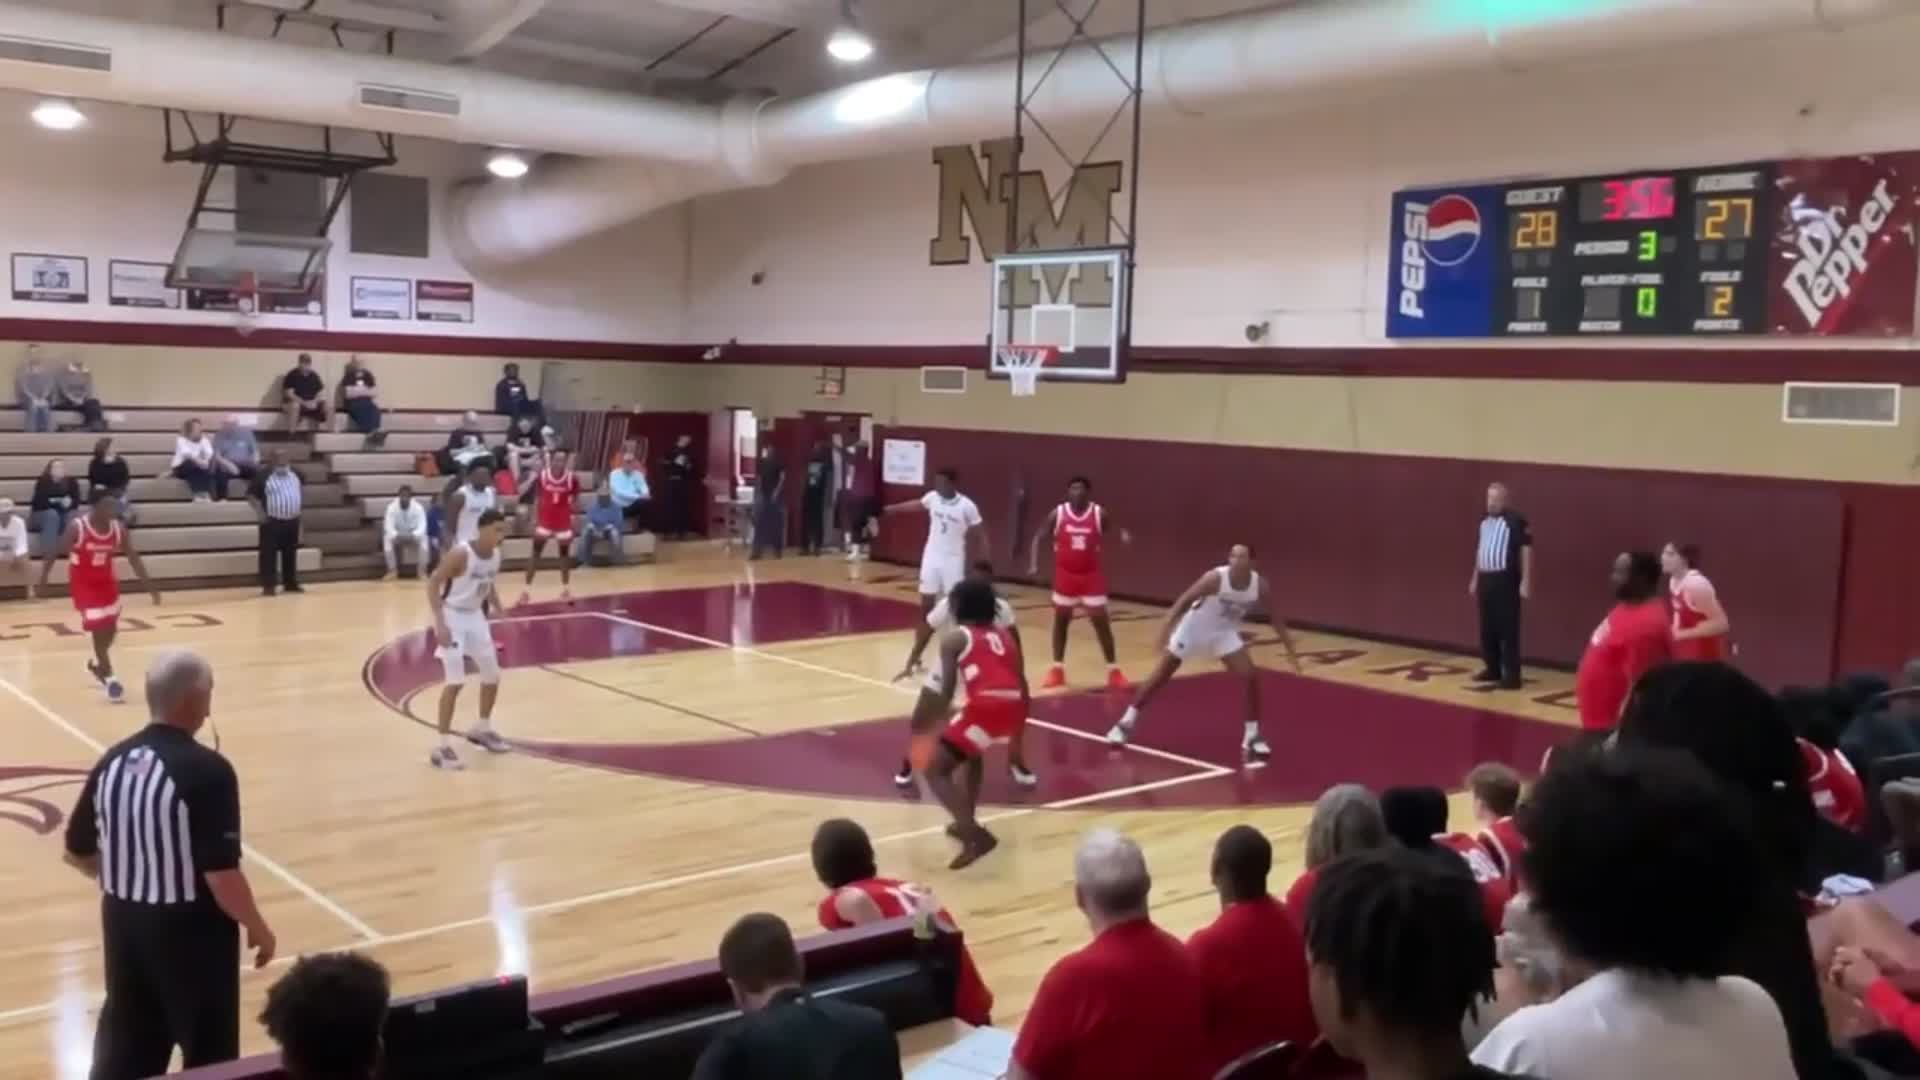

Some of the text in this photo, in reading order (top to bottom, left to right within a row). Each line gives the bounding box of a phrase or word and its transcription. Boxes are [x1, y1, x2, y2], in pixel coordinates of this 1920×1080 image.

[1516, 210, 1557, 248] 28
[1704, 197, 1753, 240] 27
[1789, 194, 1847, 270] Dr
[1400, 202, 1429, 318] PEPSI
[1637, 231, 1657, 261] 3
[1783, 178, 1896, 328] Pepper
[1636, 287, 1657, 318] 0
[1712, 285, 1734, 315] 2
